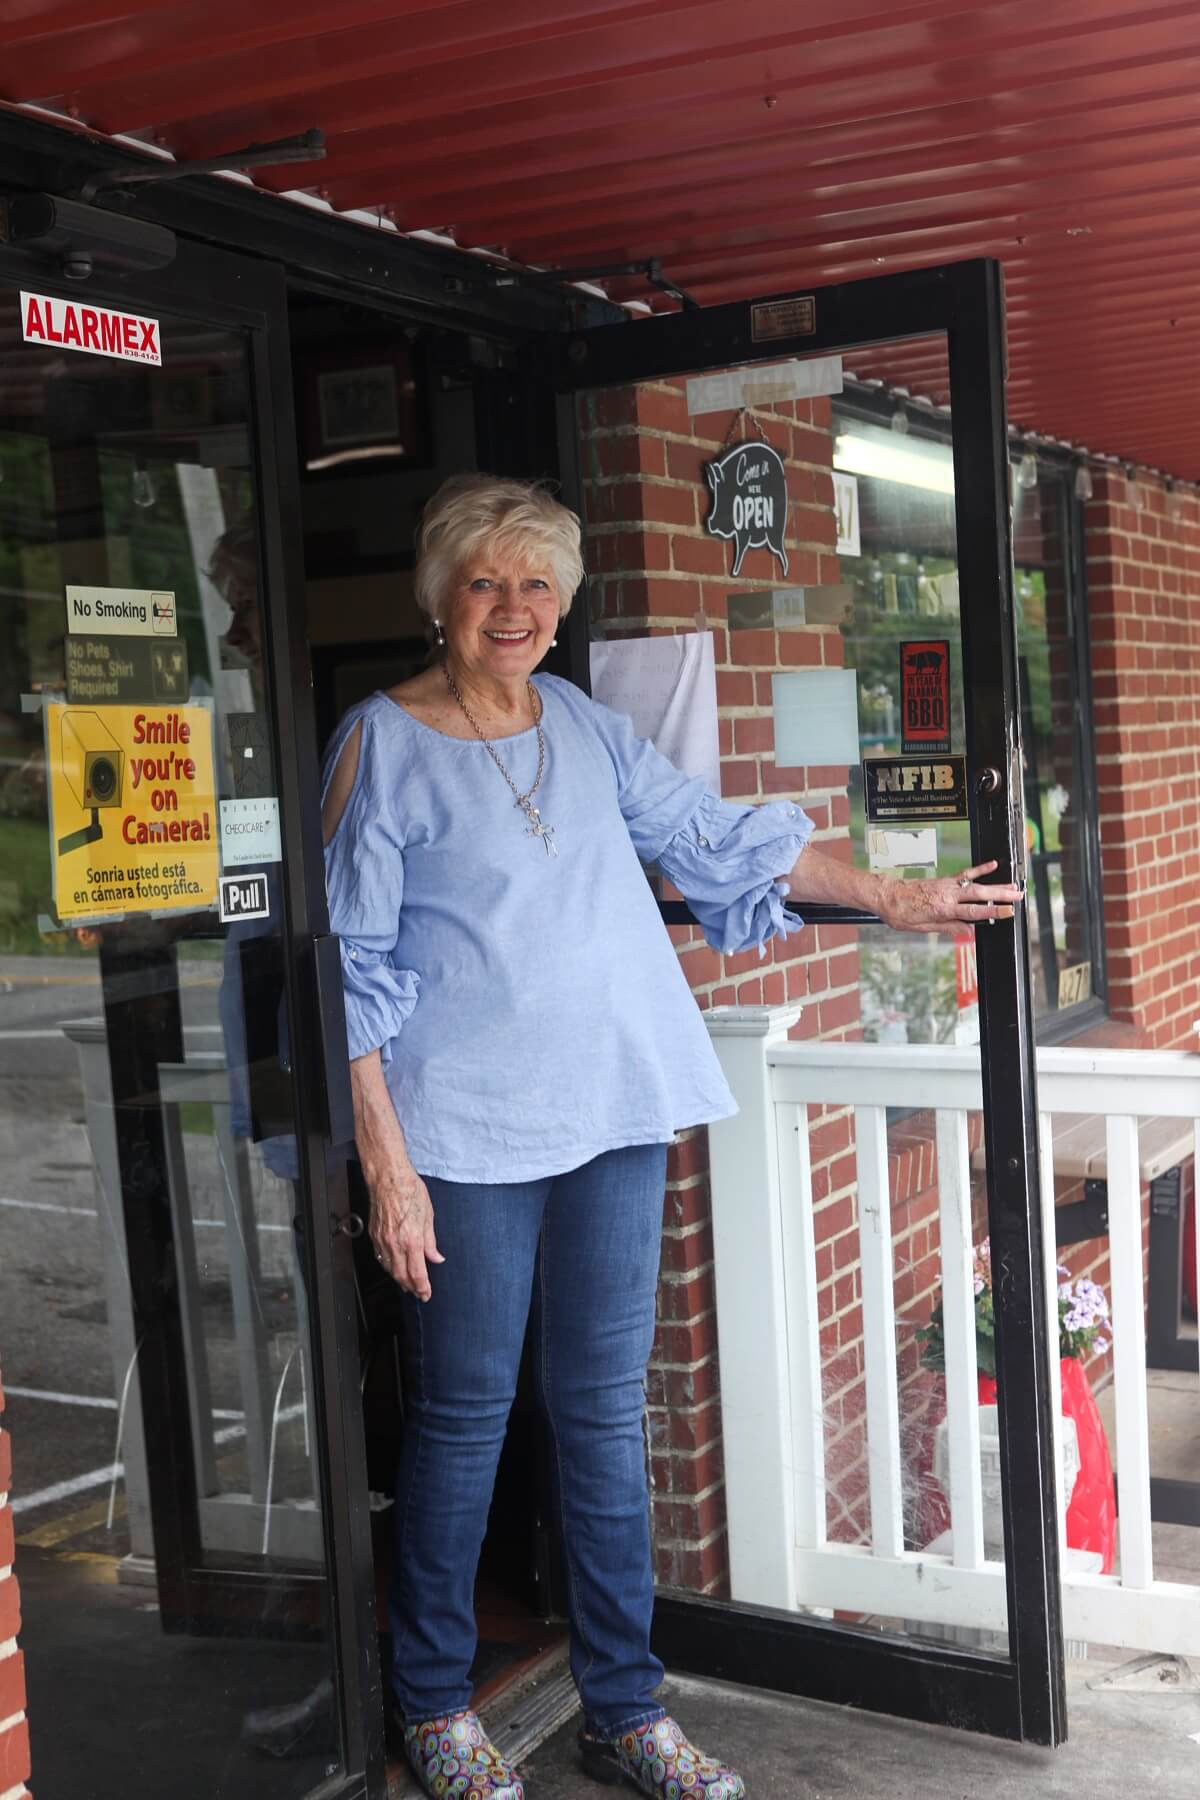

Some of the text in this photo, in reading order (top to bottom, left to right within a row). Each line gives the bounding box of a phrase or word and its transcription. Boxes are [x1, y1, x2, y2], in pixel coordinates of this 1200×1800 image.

[26, 298, 158, 354] ALARMEX
[733, 495, 774, 530] OPEN
[74, 599, 147, 622] No Smoking
[69, 641, 110, 659] No Pets
[108, 659, 134, 677] Shirt
[71, 679, 119, 699] Required
[908, 699, 945, 729] BBQ
[133, 713, 190, 744] Smile
[130, 751, 196, 789] you're
[876, 765, 954, 792] NFIB
[151, 789, 178, 811] on
[122, 812, 210, 845] Camera!
[225, 821, 264, 835] CHECKCARE
[127, 863, 159, 881] usted
[162, 861, 186, 878] está
[74, 880, 203, 903] en cámara fotográfica.
[229, 883, 260, 911] Pull
